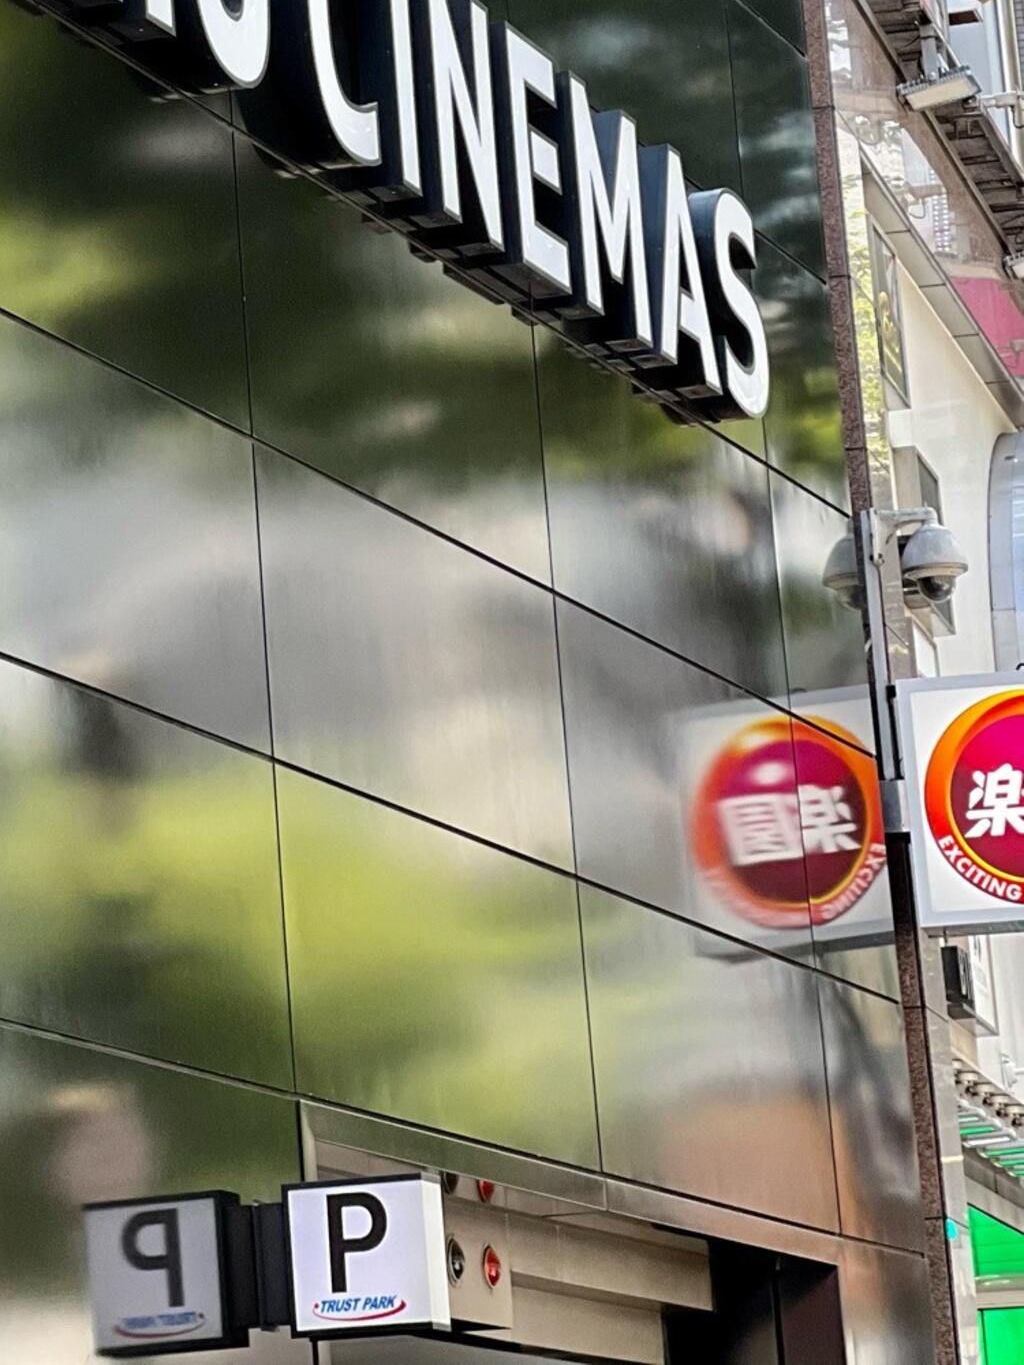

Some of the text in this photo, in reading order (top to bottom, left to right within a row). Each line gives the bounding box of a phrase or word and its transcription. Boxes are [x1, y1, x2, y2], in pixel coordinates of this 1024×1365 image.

[937, 834, 1023, 901] EXCITING
[326, 1192, 388, 1294] P
[320, 1294, 398, 1313] TRUST PARK
